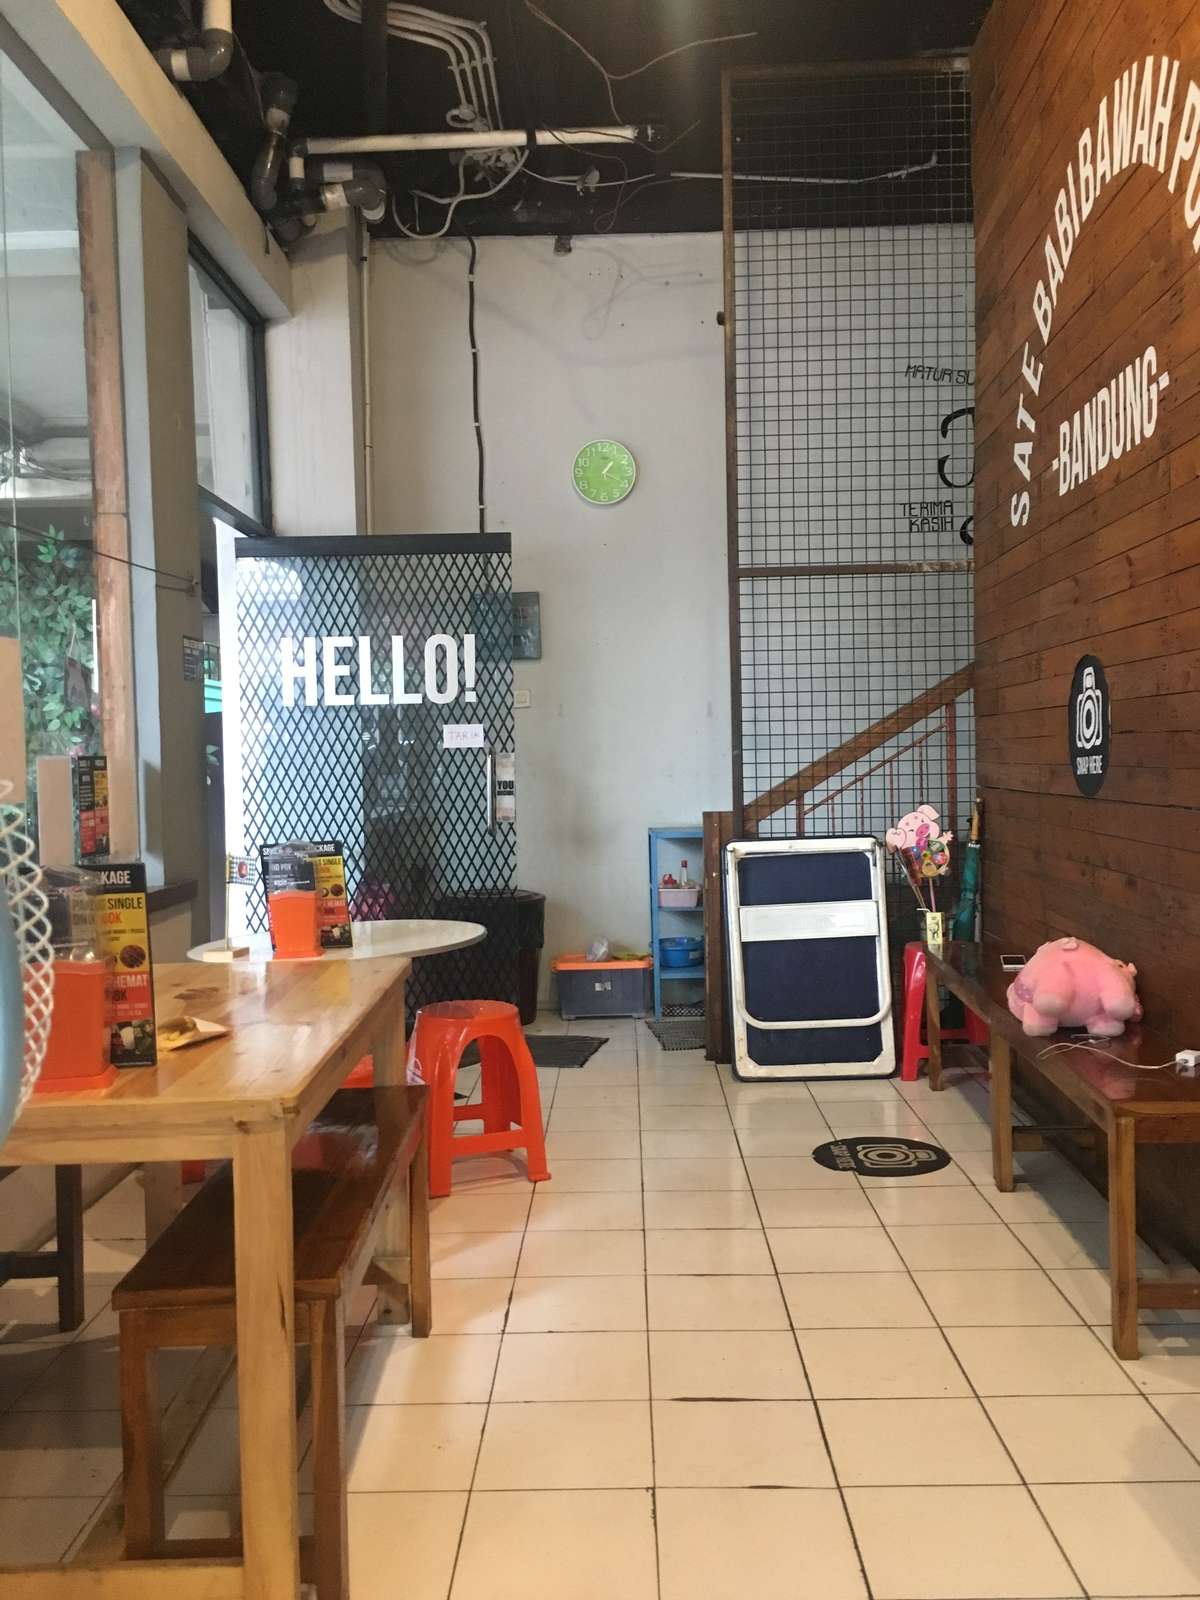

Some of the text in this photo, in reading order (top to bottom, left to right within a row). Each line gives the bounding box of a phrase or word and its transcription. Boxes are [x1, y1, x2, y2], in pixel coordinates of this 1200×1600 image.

[905, 364, 953, 383] MATUR
[1010, 342, 1043, 527] SATE
[900, 500, 953, 516] TERIMA
[910, 516, 953, 532] KASIH
[280, 633, 477, 707] HELLO!
[497, 780, 514, 790] YOU
[107, 897, 143, 910] SINGLE
